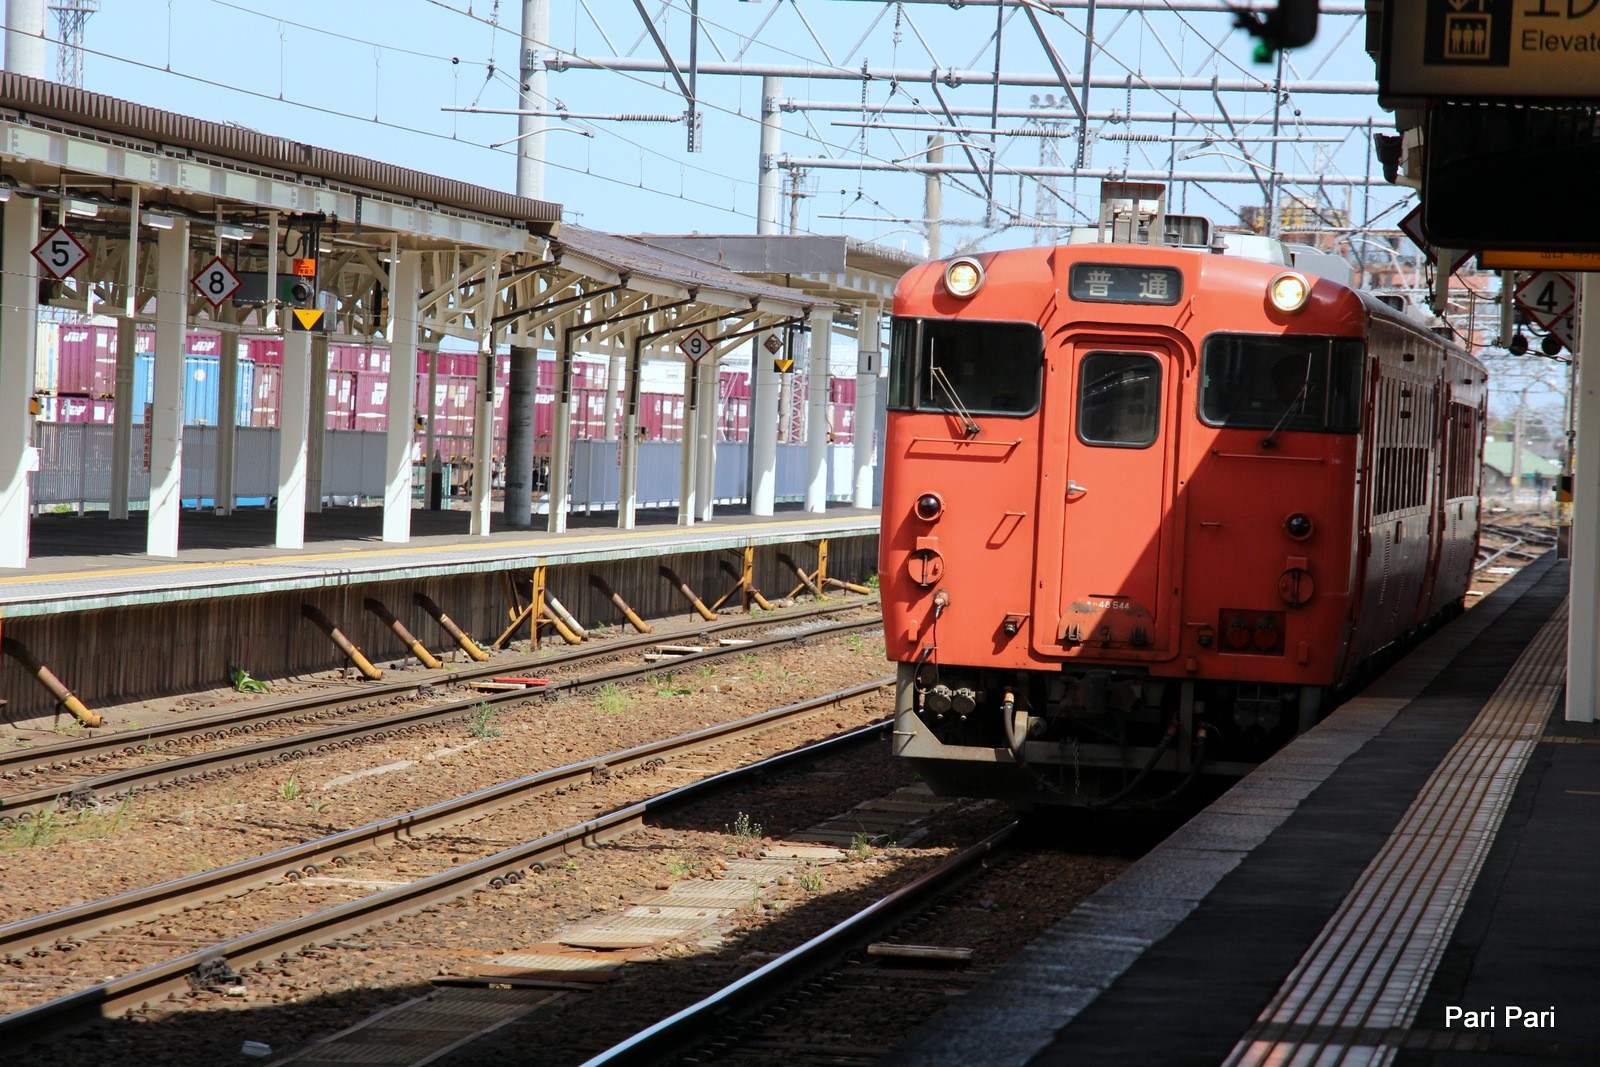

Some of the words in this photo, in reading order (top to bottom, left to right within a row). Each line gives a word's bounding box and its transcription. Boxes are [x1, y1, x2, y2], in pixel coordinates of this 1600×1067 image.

[1521, 29, 1600, 52] Elevat
[51, 240, 69, 267] 5
[208, 271, 225, 295] 8
[1084, 270, 1169, 299] 普通
[1536, 280, 1558, 313] 4
[690, 338, 702, 355] 9
[1112, 601, 1130, 610] 544
